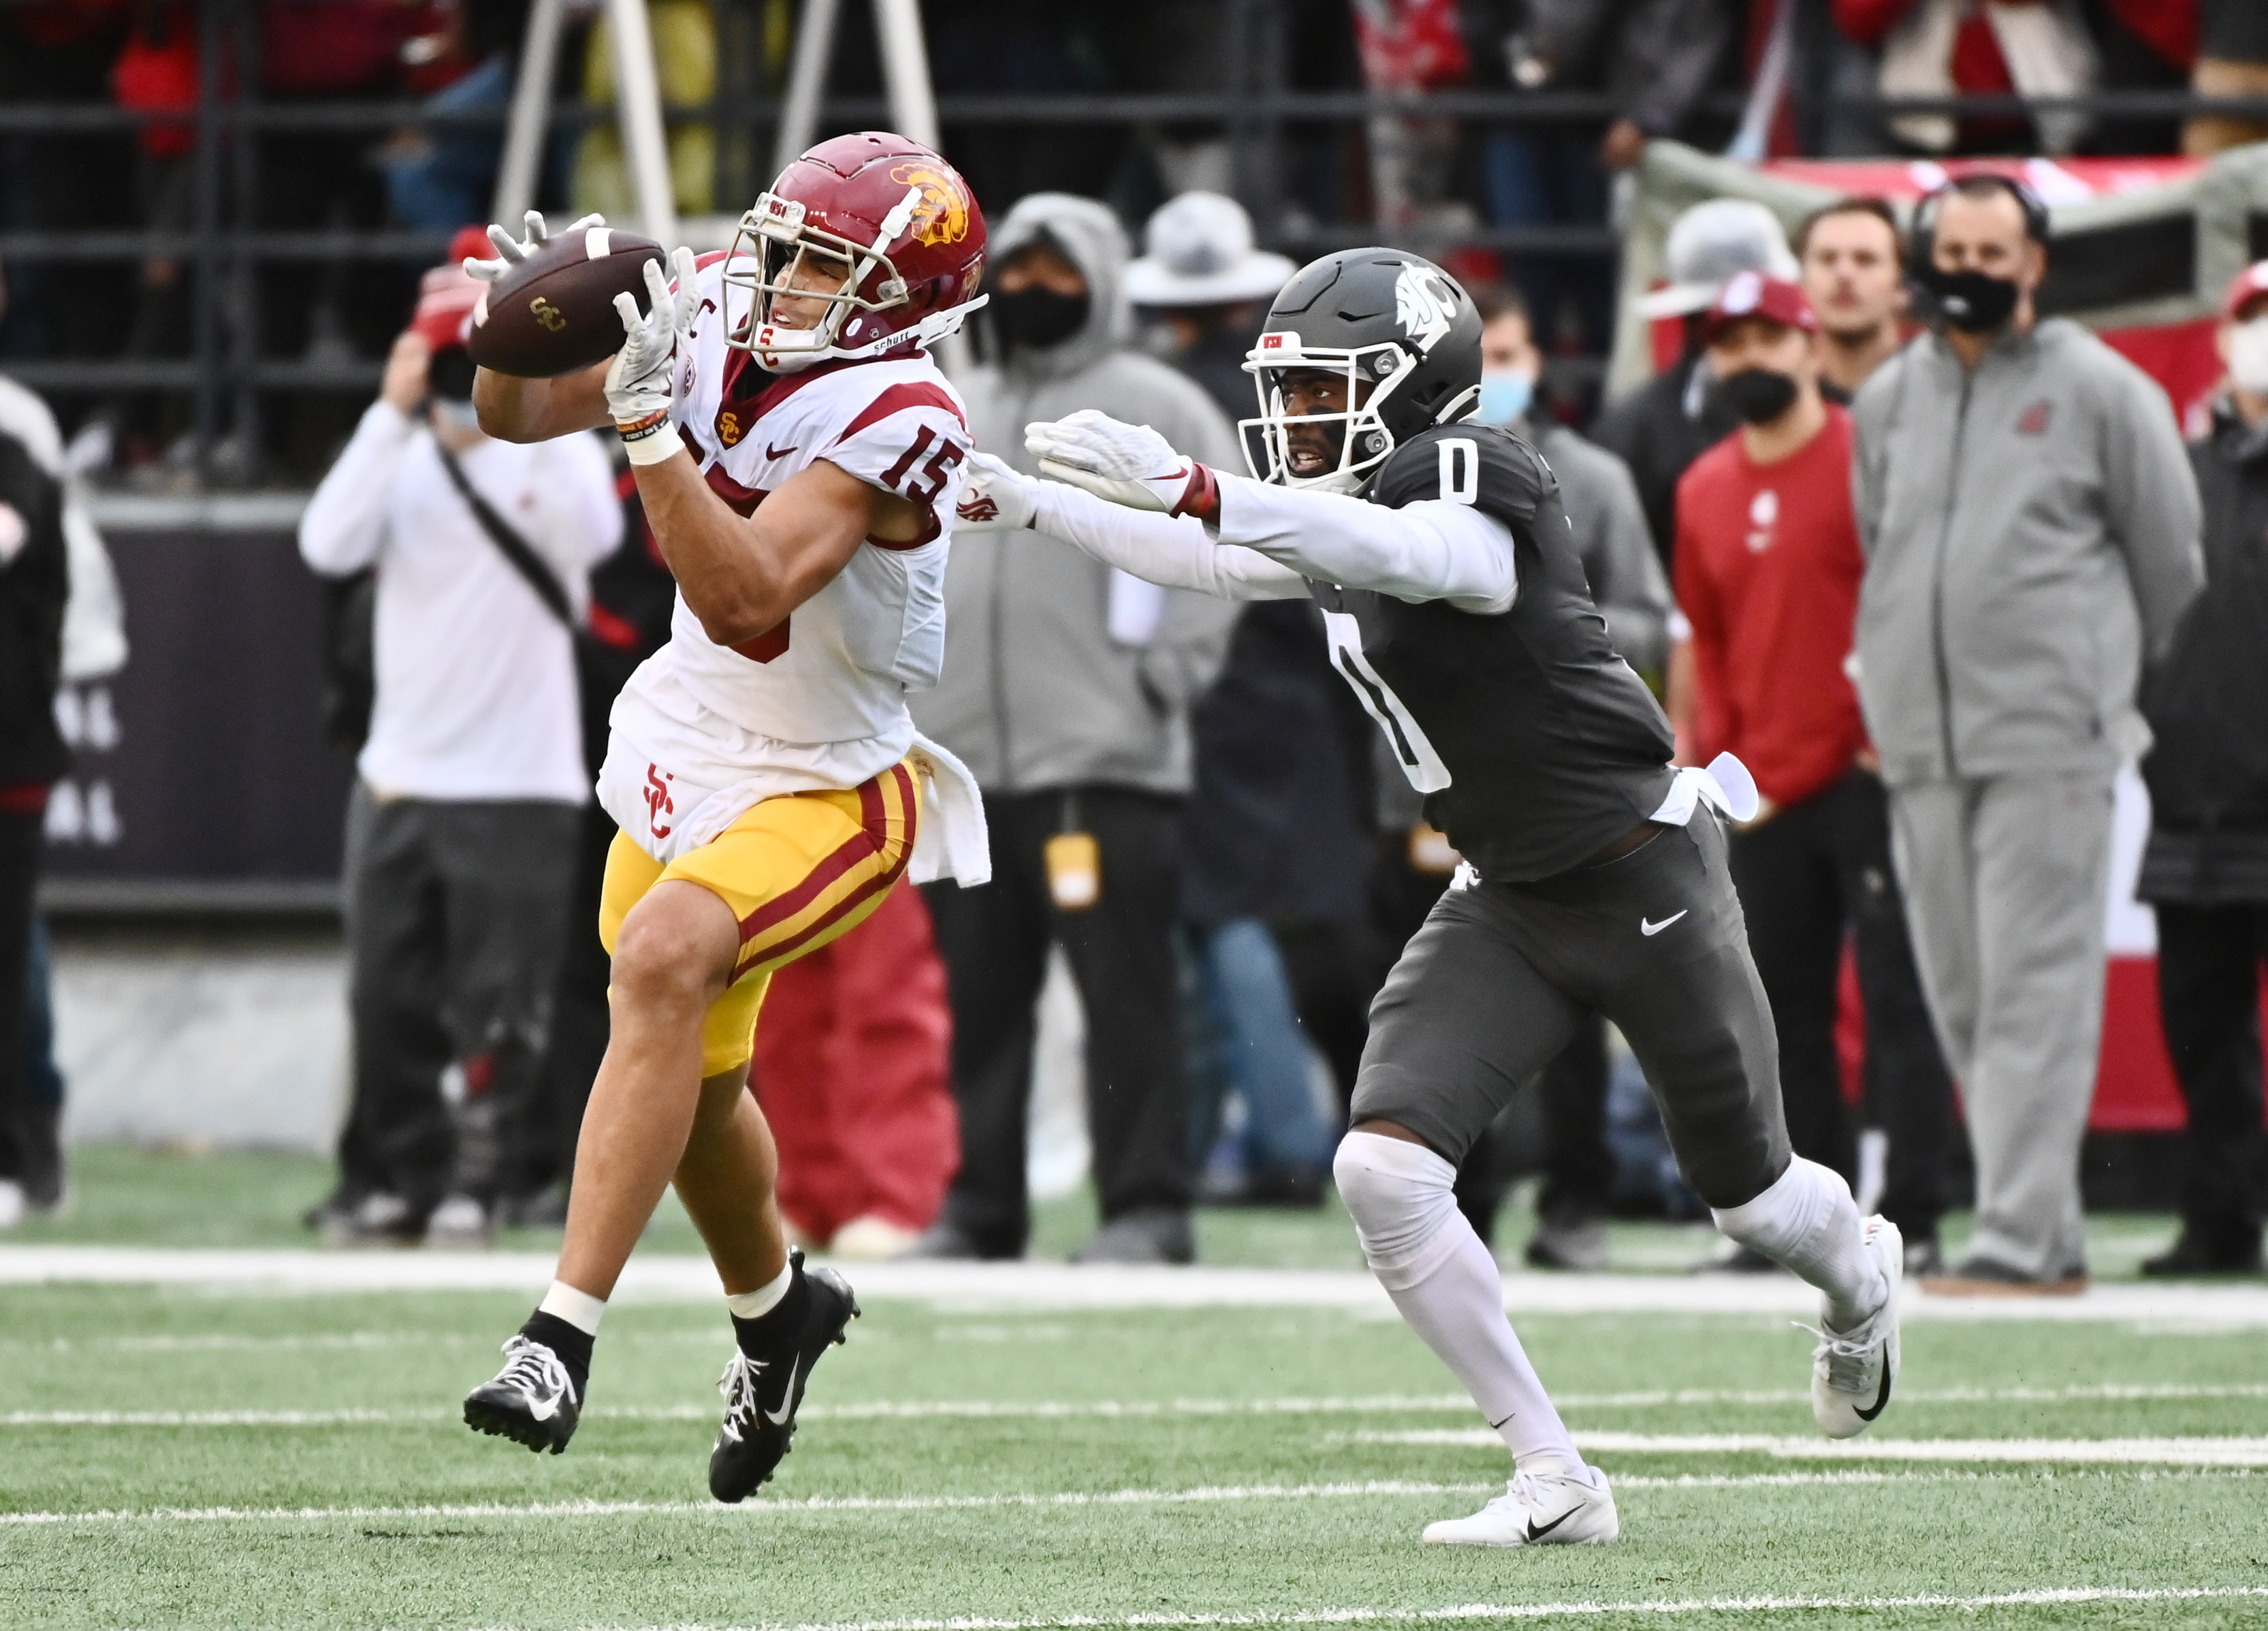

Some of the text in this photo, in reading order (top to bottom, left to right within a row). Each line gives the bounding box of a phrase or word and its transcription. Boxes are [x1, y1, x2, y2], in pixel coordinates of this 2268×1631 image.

[529, 296, 567, 332] SC
[720, 412, 740, 444] SC
[879, 423, 965, 505] 15
[1435, 437, 1480, 505] 0
[643, 761, 675, 840] SC
